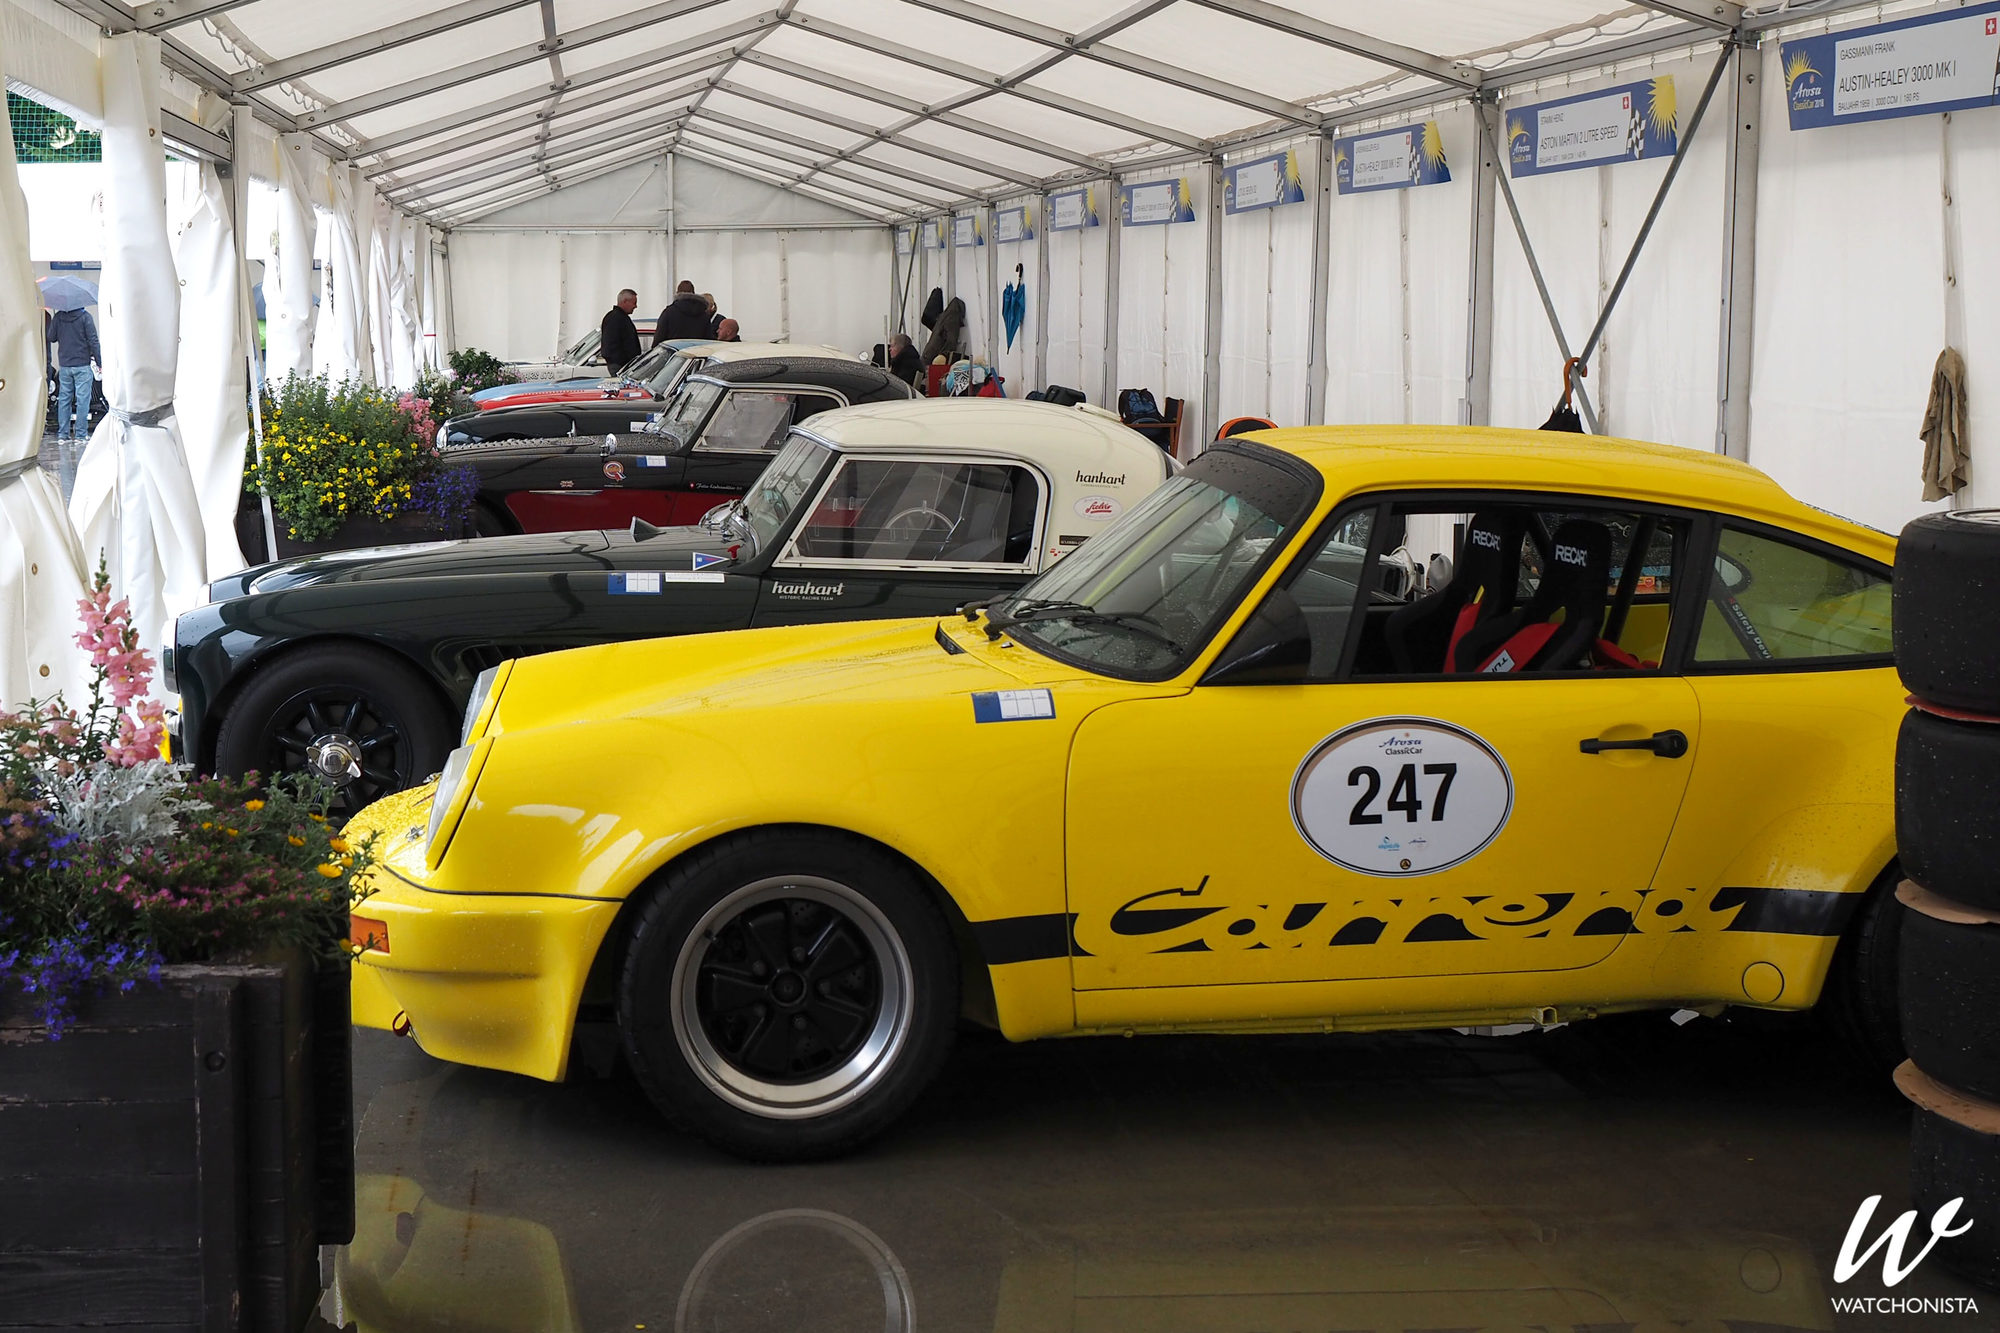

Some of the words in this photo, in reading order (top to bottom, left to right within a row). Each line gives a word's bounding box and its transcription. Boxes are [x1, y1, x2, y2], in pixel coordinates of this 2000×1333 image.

[1840, 45, 1874, 60] GASSMANN
[1875, 40, 1896, 54] FRANK
[1838, 67, 1910, 93] AUSTIN-HEALEY
[1911, 63, 1932, 83] 3000
[1936, 61, 1951, 78] MK
[1793, 83, 1821, 100] Arosa
[1540, 136, 1558, 150] ASTON
[1559, 132, 1579, 147] MARTIN
[1600, 125, 1618, 140] SPEED
[1075, 470, 1126, 485] hanhart
[1555, 544, 1588, 567] RECAR
[772, 581, 845, 596] hanhart
[1732, 603, 1757, 636] Safety
[1378, 736, 1422, 748] Arosa
[1385, 747, 1423, 756] ClassicCar
[1347, 762, 1457, 826] 247
[1073, 875, 1746, 957] Carrera
